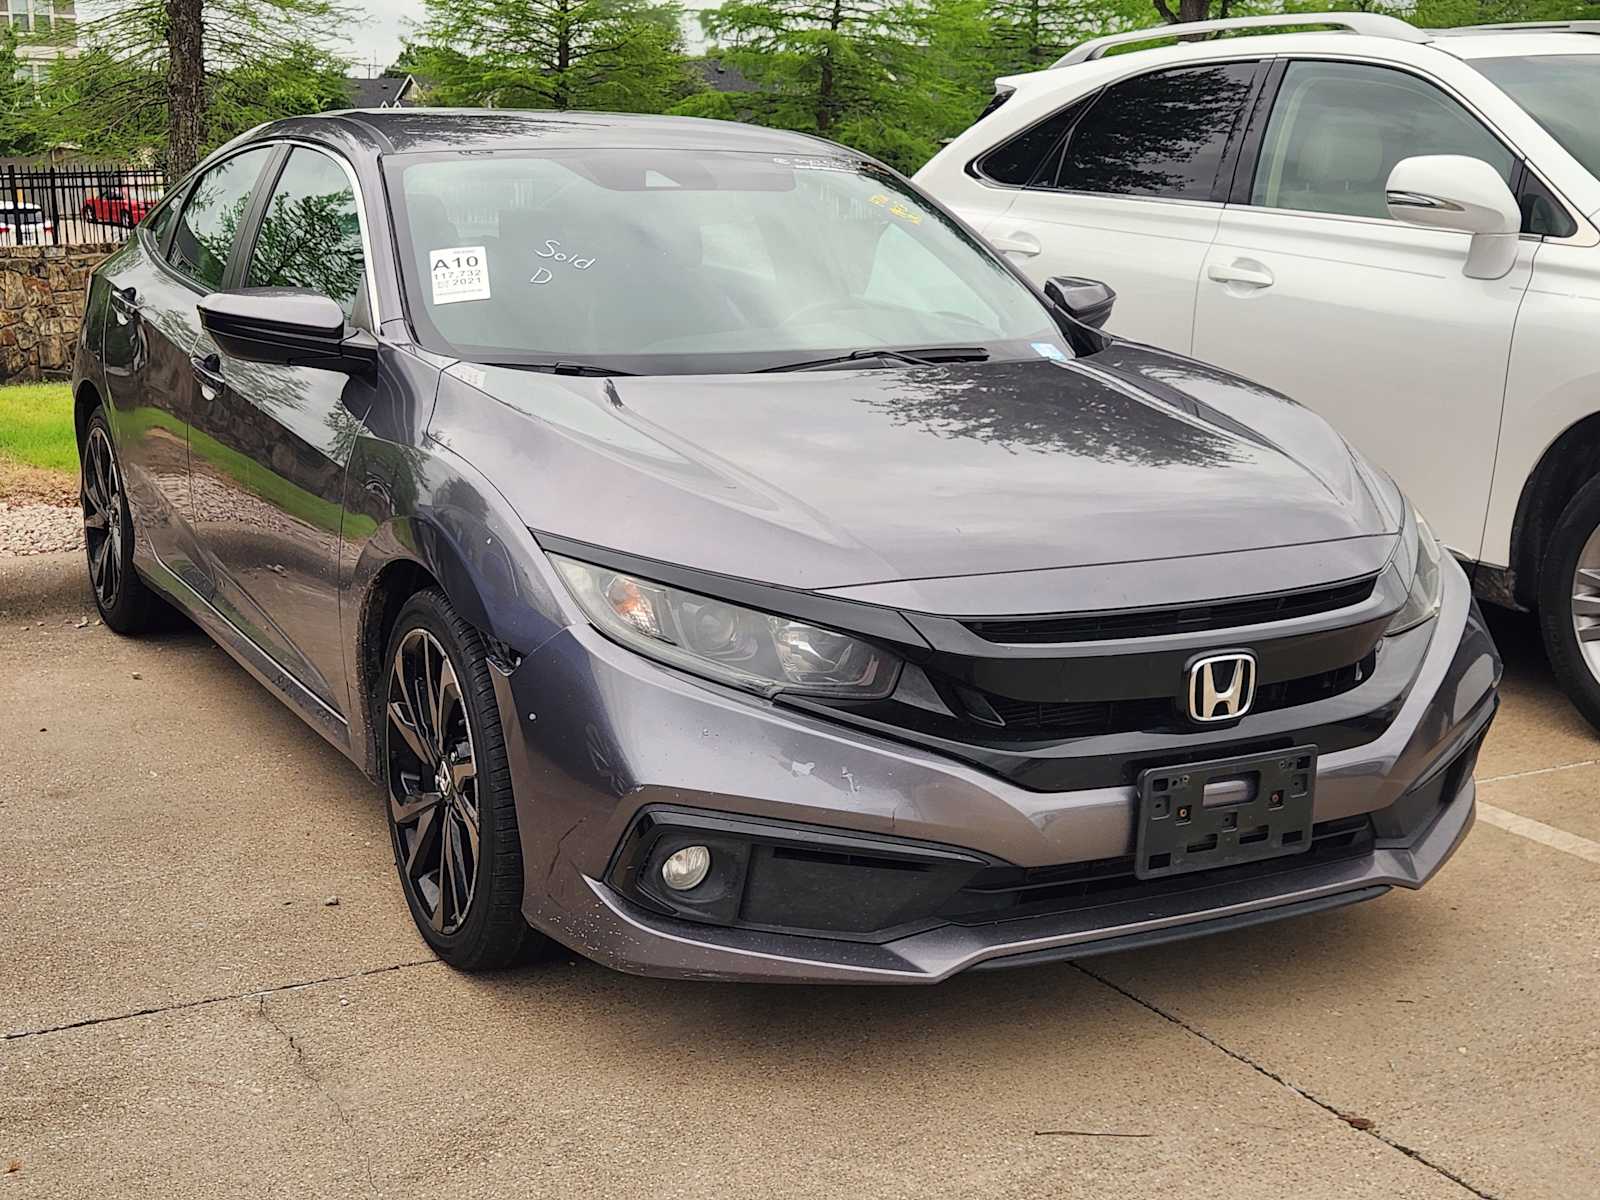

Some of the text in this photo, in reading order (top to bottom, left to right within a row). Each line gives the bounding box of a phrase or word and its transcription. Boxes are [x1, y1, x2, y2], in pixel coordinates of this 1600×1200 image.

[432, 255, 479, 271] A10
[534, 239, 597, 270] Sold
[530, 266, 553, 284] D
